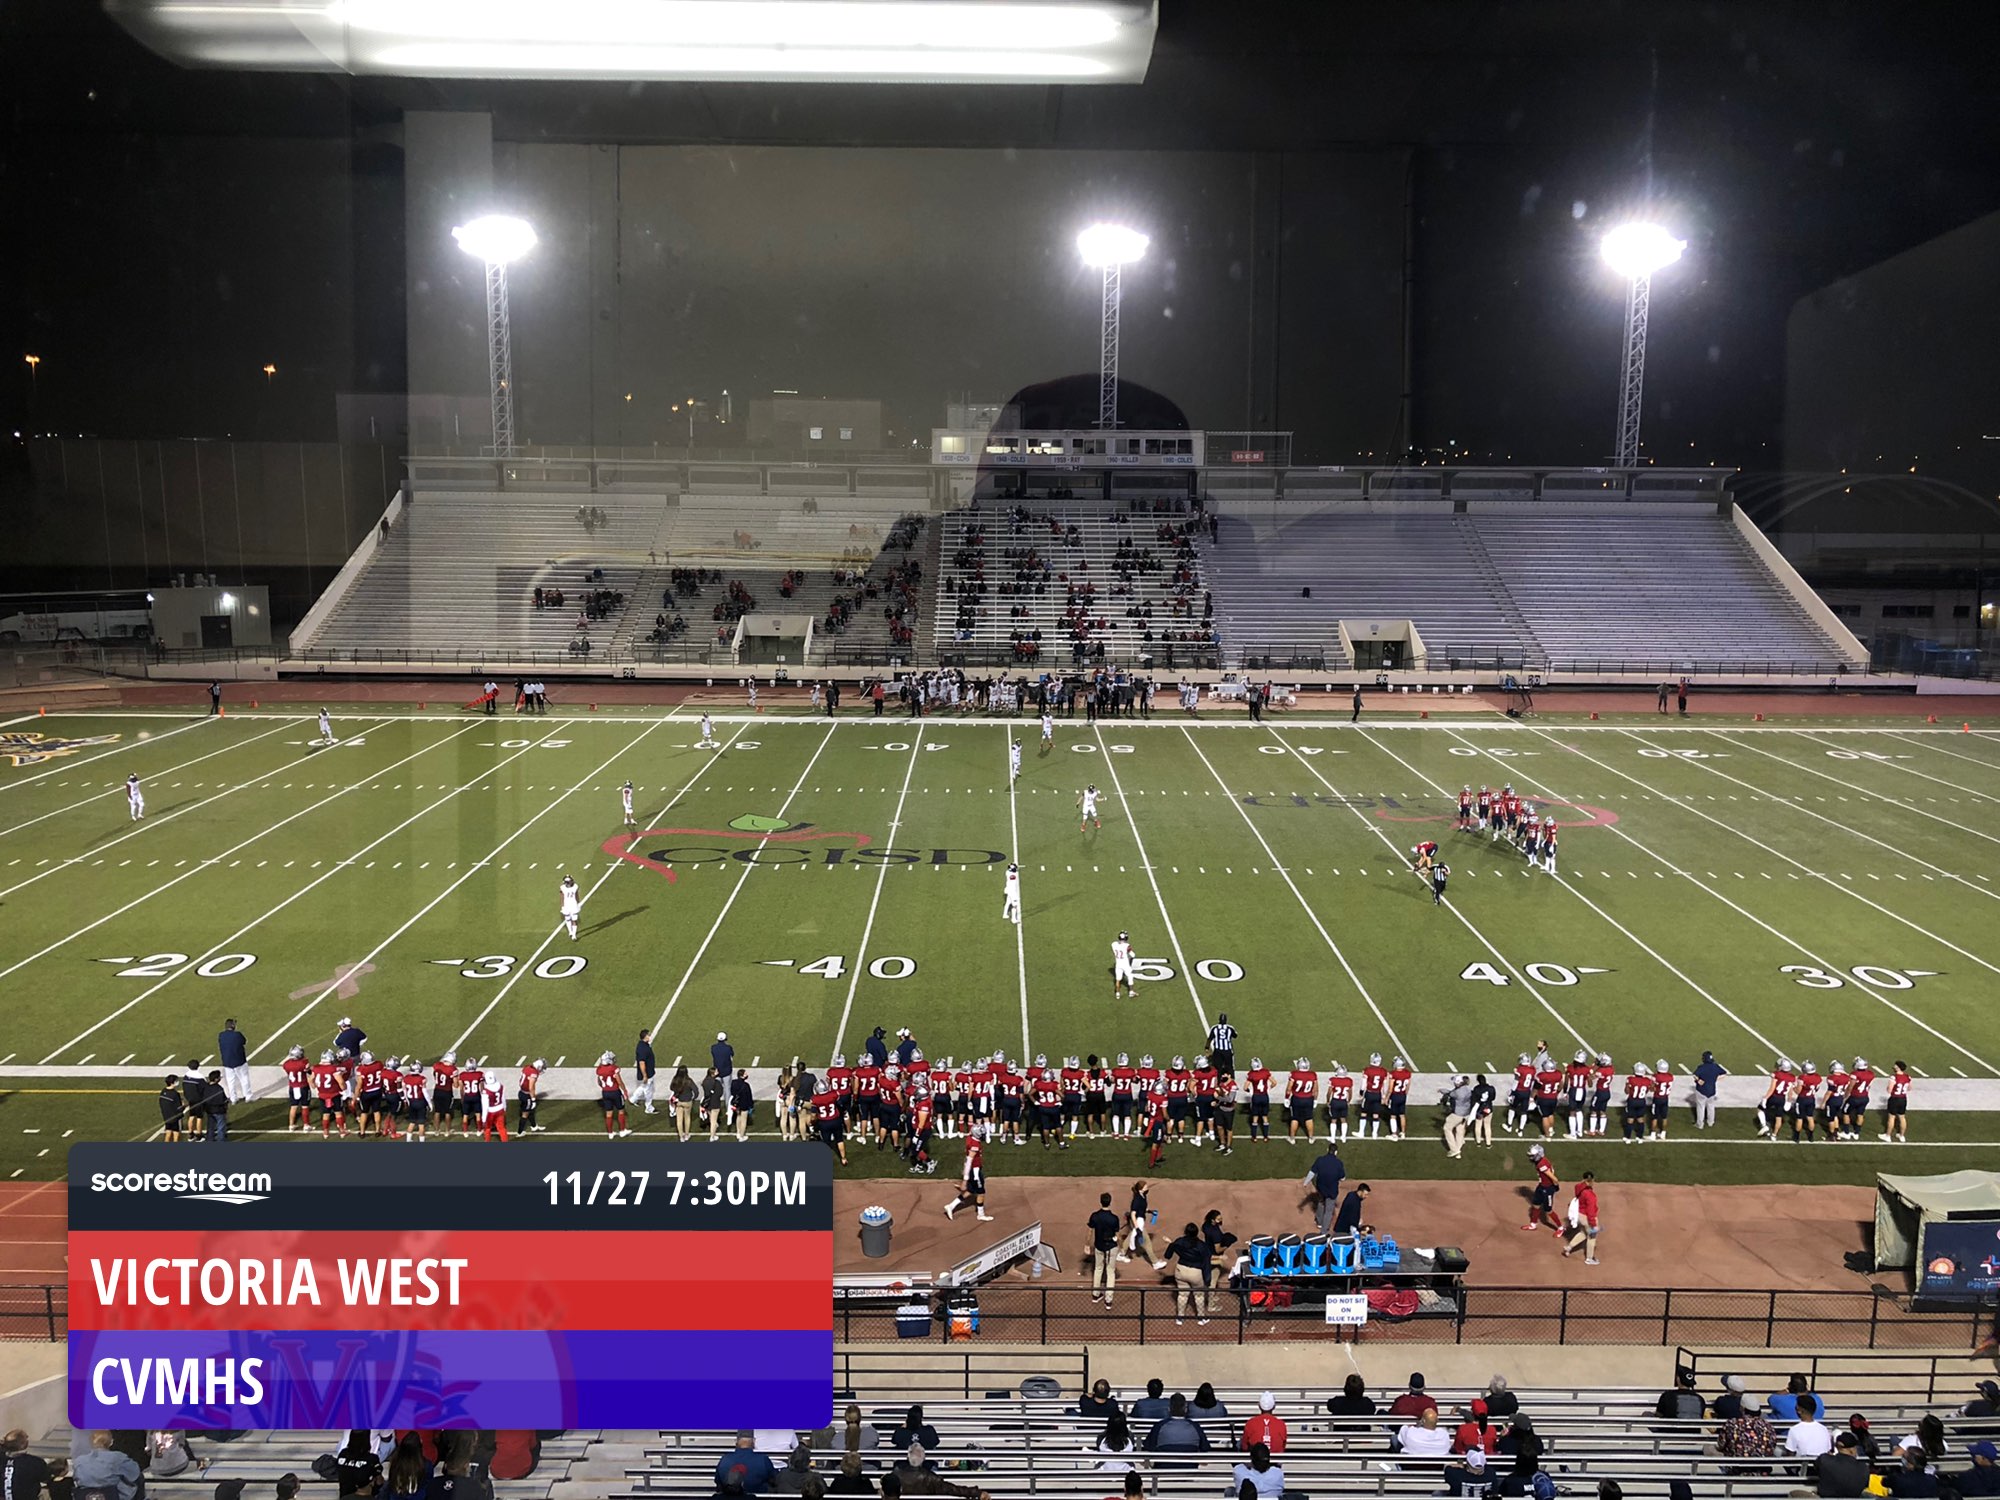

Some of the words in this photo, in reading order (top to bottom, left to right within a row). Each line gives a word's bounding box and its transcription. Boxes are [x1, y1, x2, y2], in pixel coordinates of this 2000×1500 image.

[623, 668, 636, 677] 20
[775, 669, 788, 678] 30
[1376, 674, 1388, 683] 30
[500, 739, 573, 748] 20
[884, 742, 950, 751] 40
[1071, 744, 1135, 753] 50
[1258, 746, 1324, 755] 40
[1448, 748, 1519, 756] 30
[648, 847, 1006, 865] CCISD
[116, 953, 258, 978] 20
[461, 954, 589, 979] 30
[798, 955, 917, 979] 40
[1131, 957, 1246, 983] 50
[1460, 961, 1581, 987] 40
[1780, 963, 1915, 990] 30
[1219, 1029, 1227, 1039] S
[289, 1071, 302, 1083] 41
[315, 1073, 332, 1088] 42
[366, 1071, 382, 1086] 35
[831, 1077, 849, 1090] 65
[860, 1077, 876, 1090] 73
[1371, 1075, 1380, 1089] 5
[1523, 1074, 1532, 1088] 8
[1573, 1074, 1585, 1087] 11
[463, 1080, 478, 1094] 36
[1003, 1085, 1017, 1096] 34
[1064, 1079, 1079, 1091] 32
[1090, 1079, 1104, 1091] 59
[1116, 1079, 1131, 1090] 57
[1141, 1079, 1155, 1091] 37
[1170, 1080, 1187, 1092] 66
[1257, 1079, 1265, 1092] 4
[1295, 1081, 1313, 1093] 70
[405, 1084, 418, 1099] 21
[1333, 1087, 1348, 1100] 25
[1633, 1085, 1646, 1098] 18
[819, 1103, 836, 1118] 53
[995, 1240, 1018, 1258] COASTAL
[1019, 1232, 1034, 1245] BEND
[993, 1250, 1011, 1265] CHEVY
[1011, 1239, 1035, 1255] DEALERS
